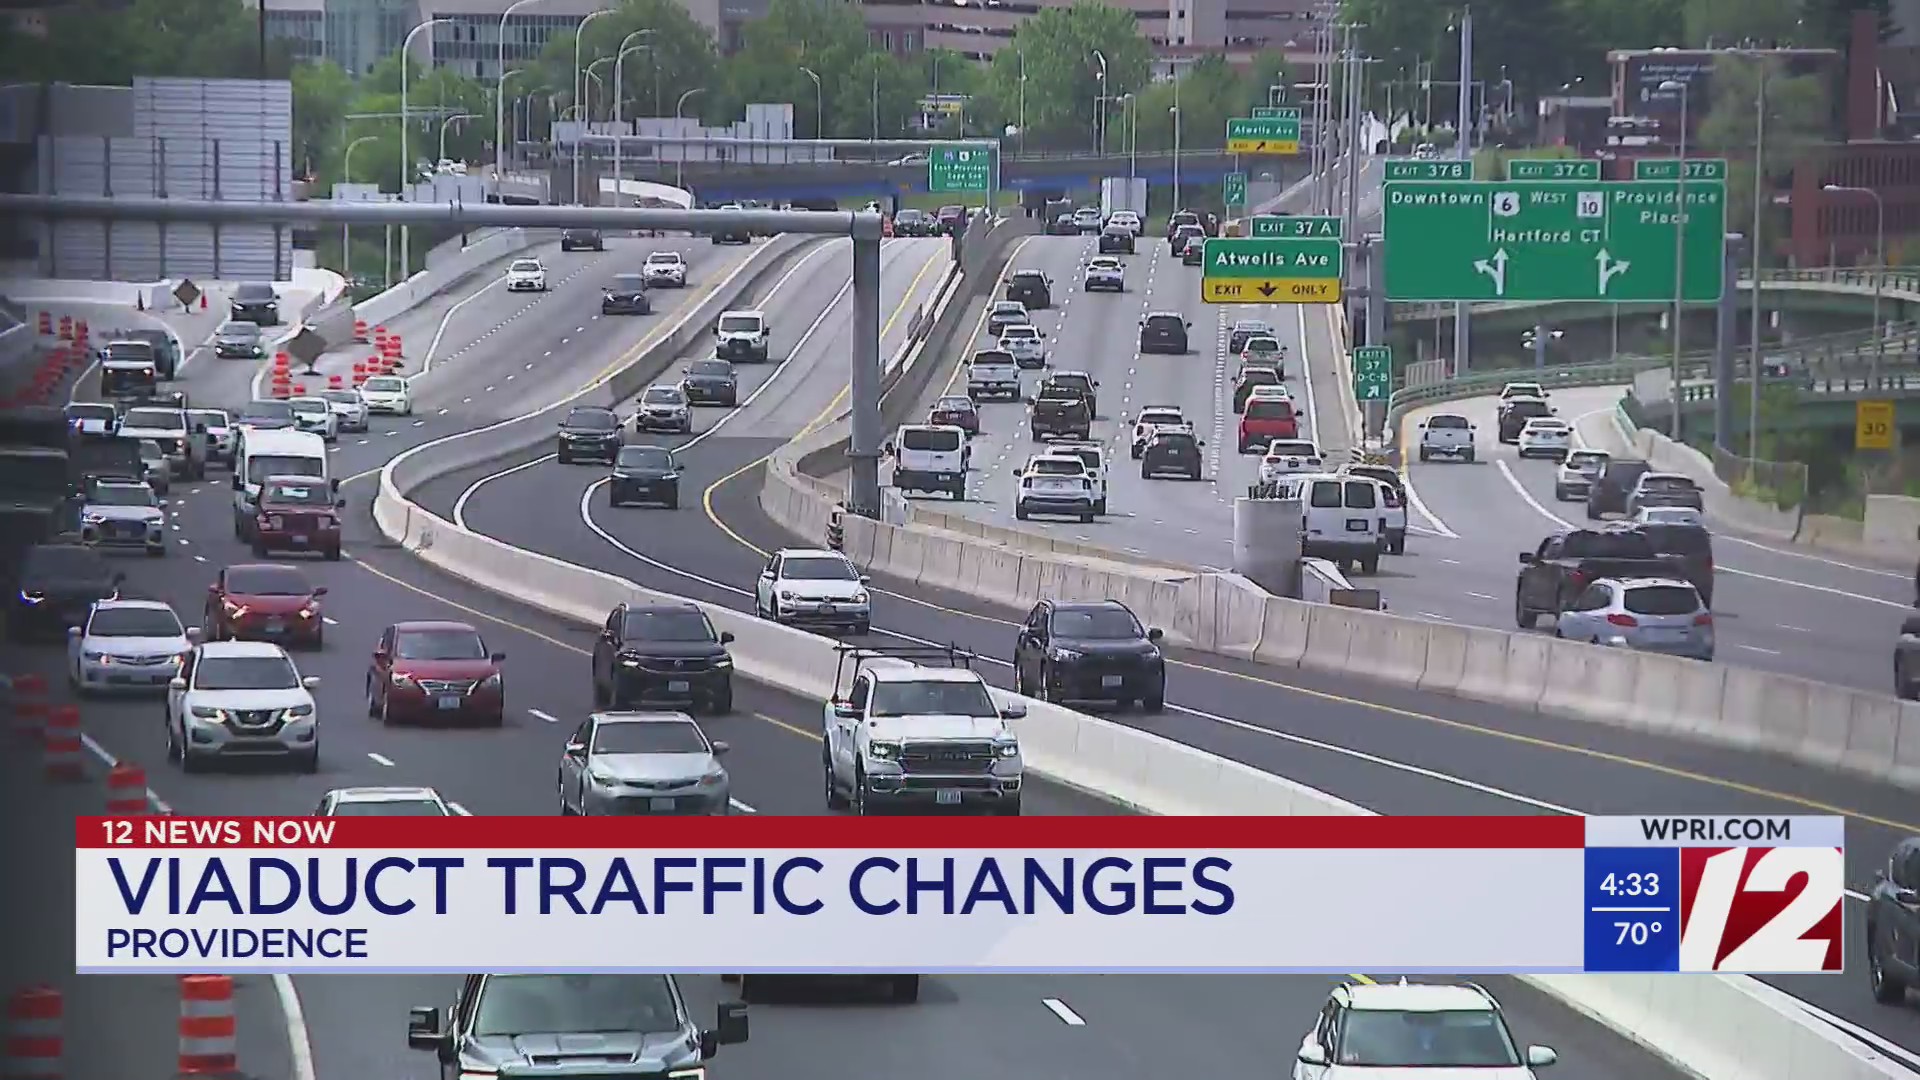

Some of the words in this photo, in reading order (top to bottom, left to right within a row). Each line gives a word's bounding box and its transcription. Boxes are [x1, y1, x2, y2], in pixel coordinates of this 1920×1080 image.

[1234, 125, 1270, 135] Atwells
[1276, 126, 1293, 134] Ave
[1394, 166, 1418, 176] EXIT
[1520, 166, 1543, 175] EXIT
[1646, 166, 1671, 175] EXIT
[1392, 191, 1484, 204] Downtown
[1502, 198, 1512, 212] 6
[1530, 191, 1567, 203] WEST
[1582, 201, 1598, 214] 10
[1640, 211, 1690, 224] Place
[1260, 223, 1284, 232] EXIT
[1494, 229, 1571, 242] Hartford
[1581, 229, 1601, 242] CT
[1216, 252, 1284, 266] Atwells
[1295, 252, 1329, 266] Ave
[1215, 285, 1242, 296] EXIT
[1292, 285, 1328, 296] ONLY
[1366, 361, 1380, 370] 37
[1863, 423, 1887, 435] 30
